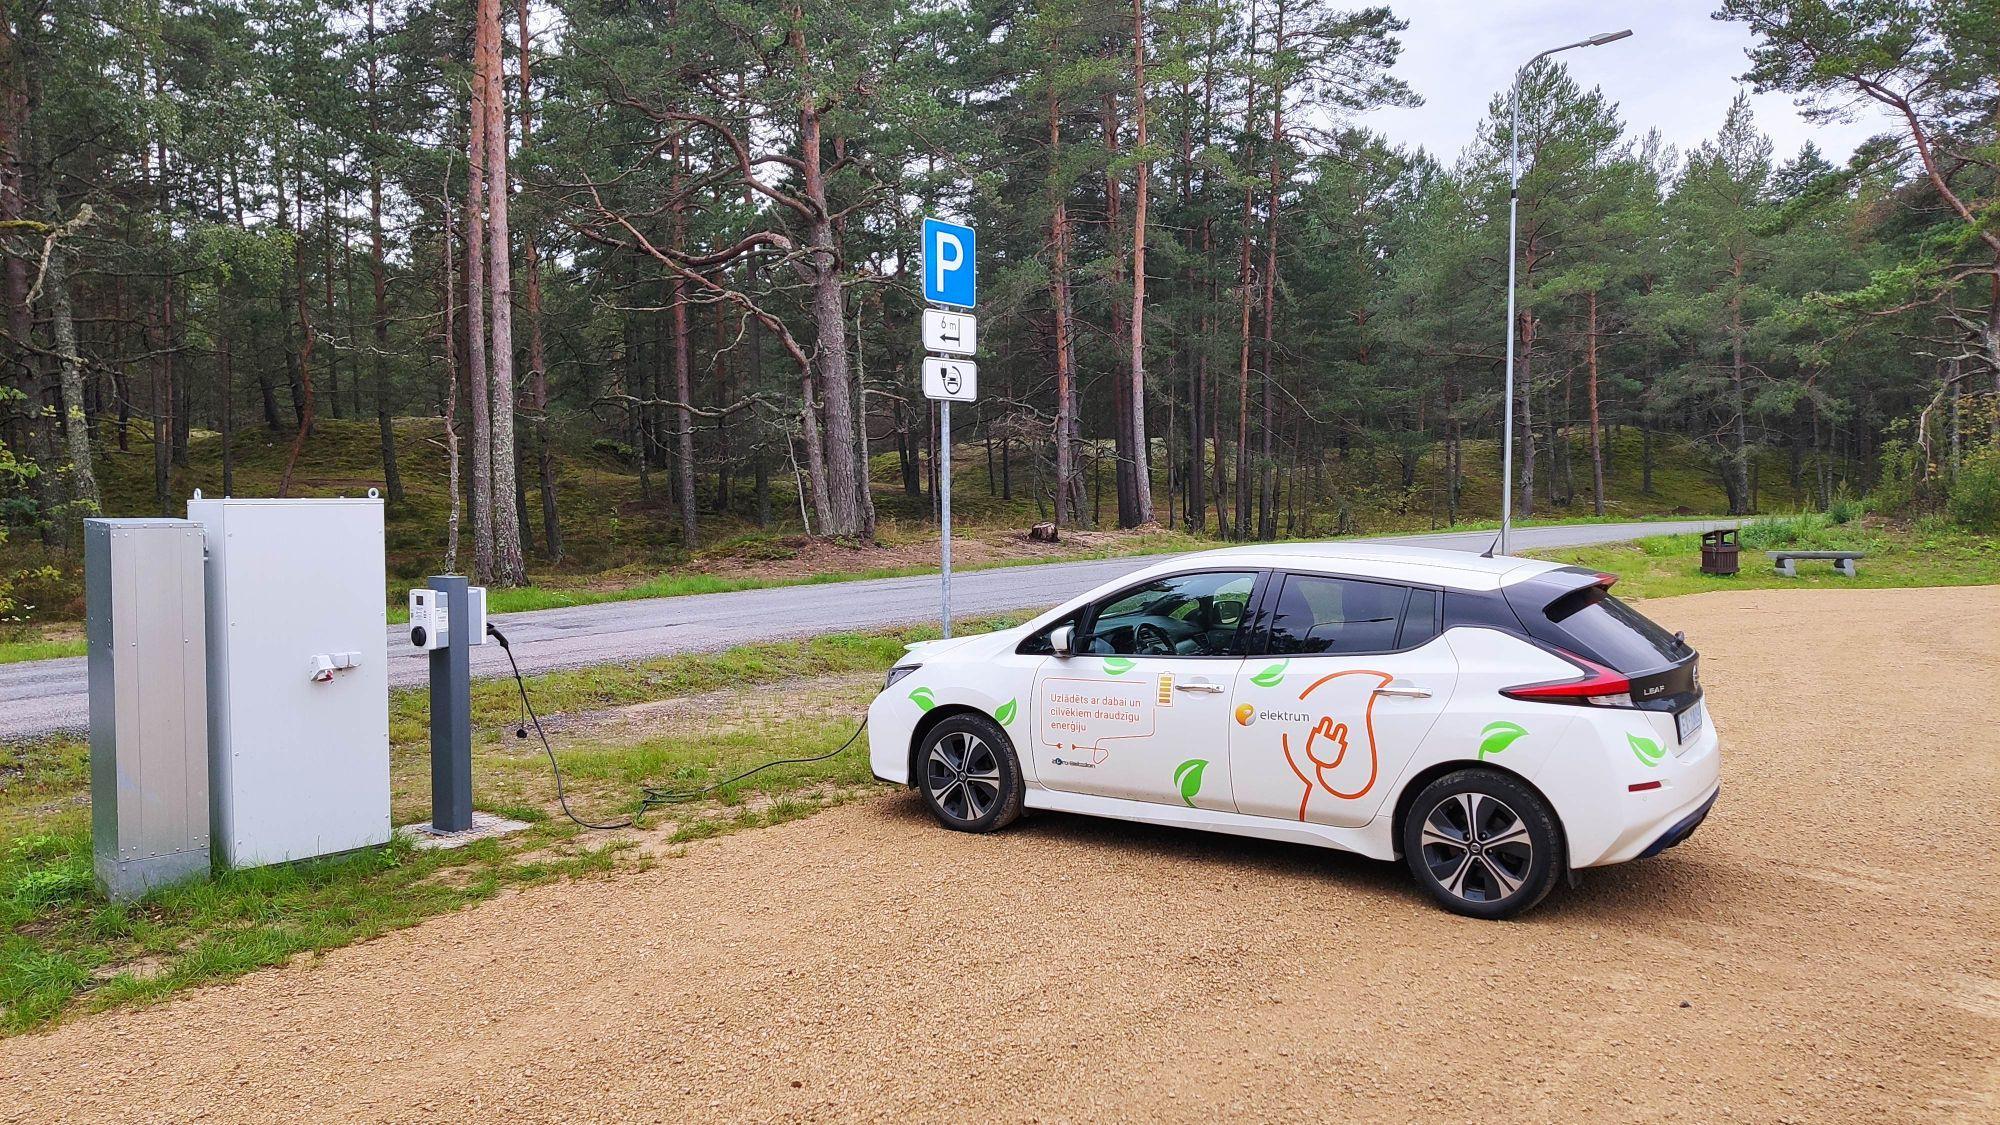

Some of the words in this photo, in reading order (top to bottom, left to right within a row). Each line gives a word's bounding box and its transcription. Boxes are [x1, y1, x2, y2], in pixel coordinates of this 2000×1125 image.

[936, 231, 964, 293] P
[940, 316, 947, 330] 6
[949, 321, 957, 331] m
[1643, 685, 1665, 696] LEAF
[1090, 697, 1100, 705] ar
[1102, 696, 1127, 706] dabai
[1129, 699, 1141, 707] un
[1050, 707, 1092, 718] cilvēkiem
[1094, 709, 1140, 723] draudzīgu
[1259, 709, 1310, 722] elektrum
[1050, 720, 1087, 733] enerģiju
